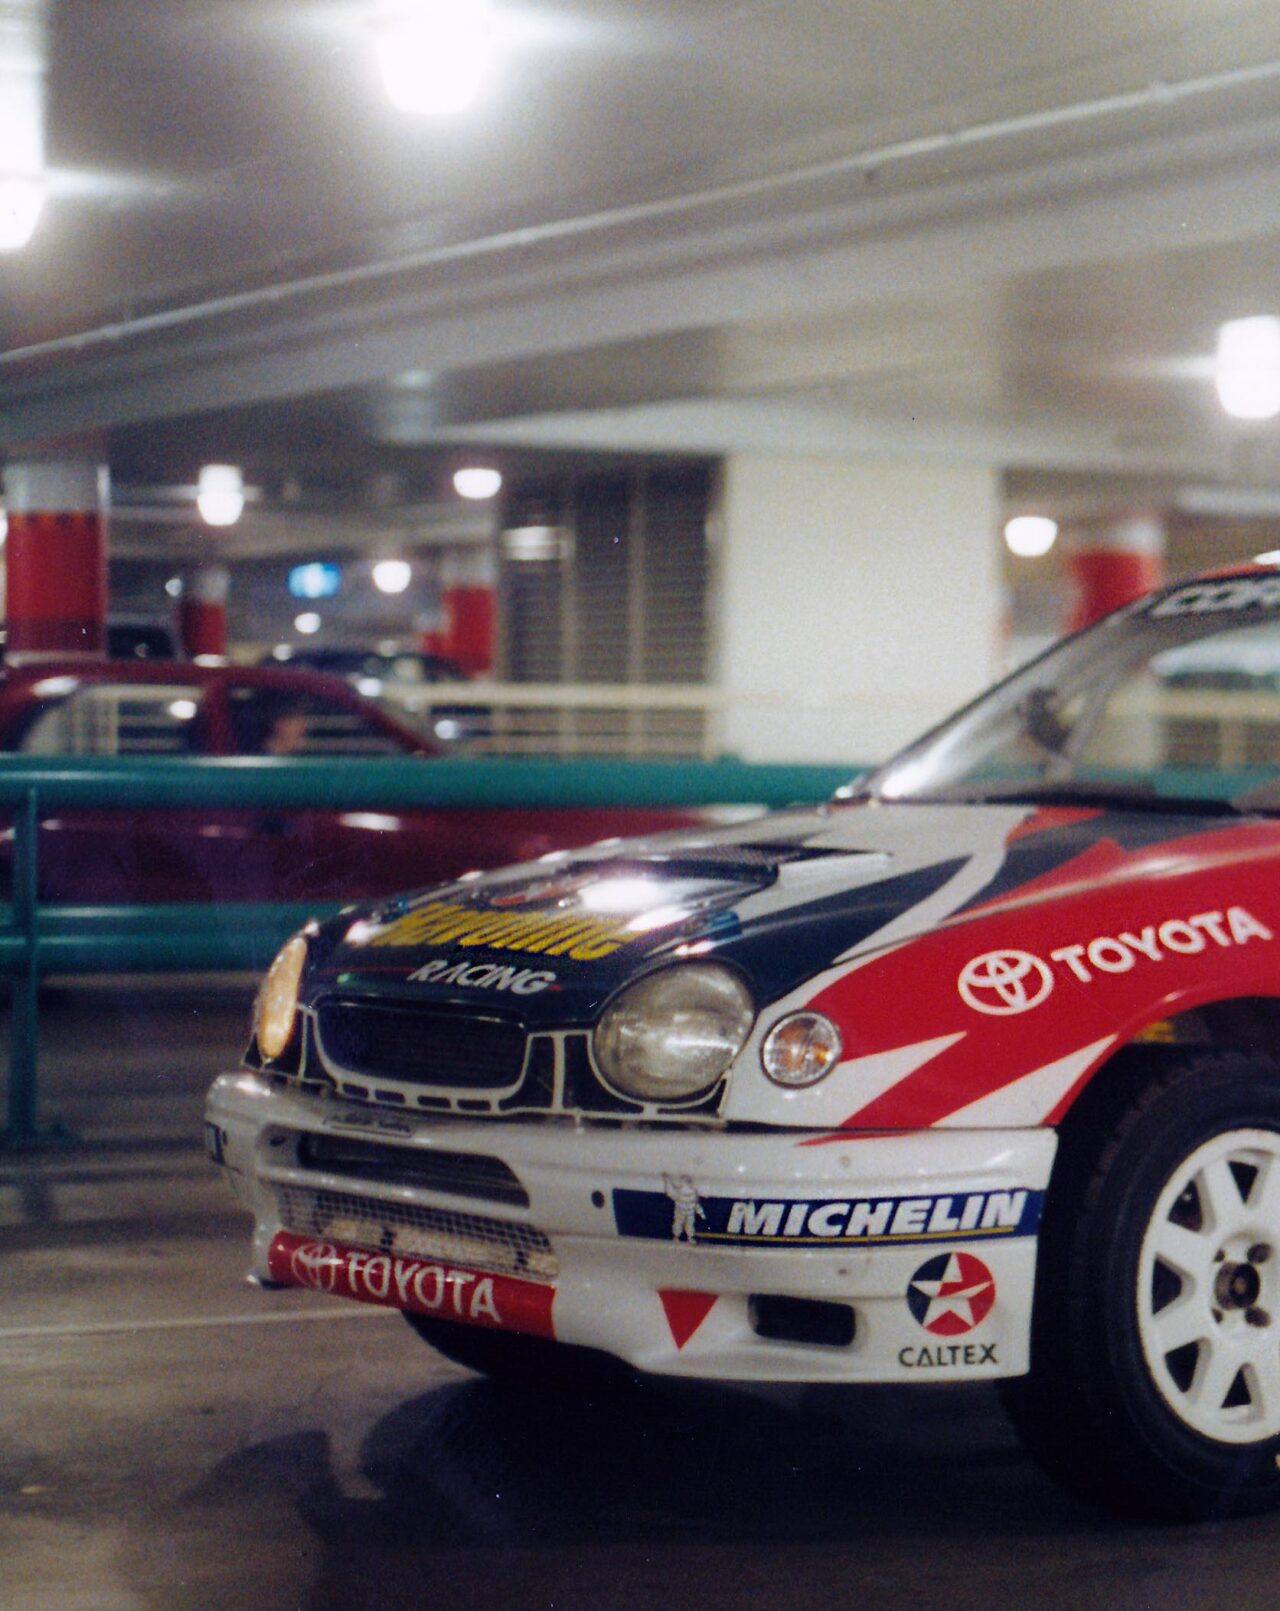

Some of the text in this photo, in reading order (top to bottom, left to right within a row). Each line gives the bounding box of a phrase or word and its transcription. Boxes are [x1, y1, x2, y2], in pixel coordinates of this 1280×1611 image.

[1051, 906, 1272, 984] TOYOTA
[406, 958, 557, 995] RACING
[726, 1191, 1028, 1236] MICHELIN
[347, 1252, 503, 1324] TOYOTA
[900, 1341, 999, 1368] CALTEX
